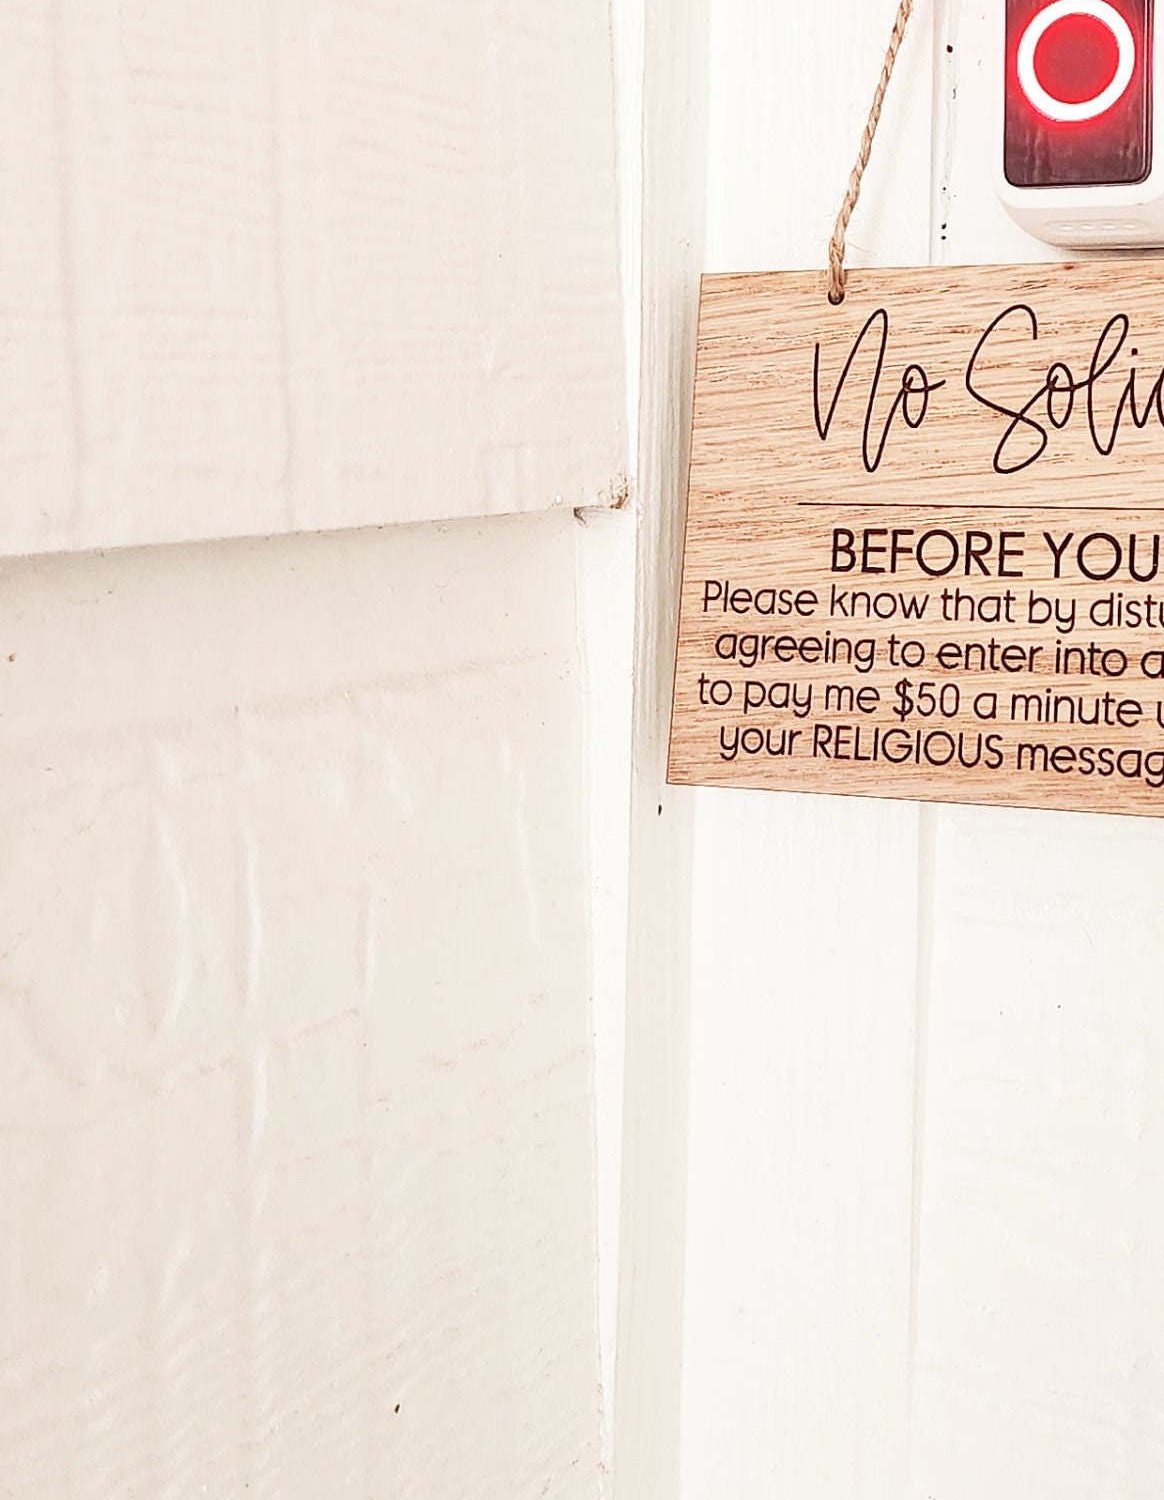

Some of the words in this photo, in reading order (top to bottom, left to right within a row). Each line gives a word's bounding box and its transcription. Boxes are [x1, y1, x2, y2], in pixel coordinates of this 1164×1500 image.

[813, 309, 946, 472] No
[831, 528, 1025, 577] BEFORE
[1043, 532, 1160, 582] YOU
[702, 580, 818, 616] Please
[831, 584, 929, 619] know
[941, 588, 1016, 622] that
[1028, 590, 1075, 634] by
[715, 631, 875, 673] agreeing
[888, 634, 925, 667] to
[935, 638, 1043, 672] enter
[1056, 640, 1127, 676] into
[698, 673, 732, 705] to
[744, 681, 812, 718] pay
[825, 685, 880, 713] me
[893, 678, 959, 722] $50
[974, 693, 997, 719] a
[1011, 688, 1143, 727] minute
[720, 726, 802, 761] your
[813, 724, 1003, 769] RELIGIOUS
